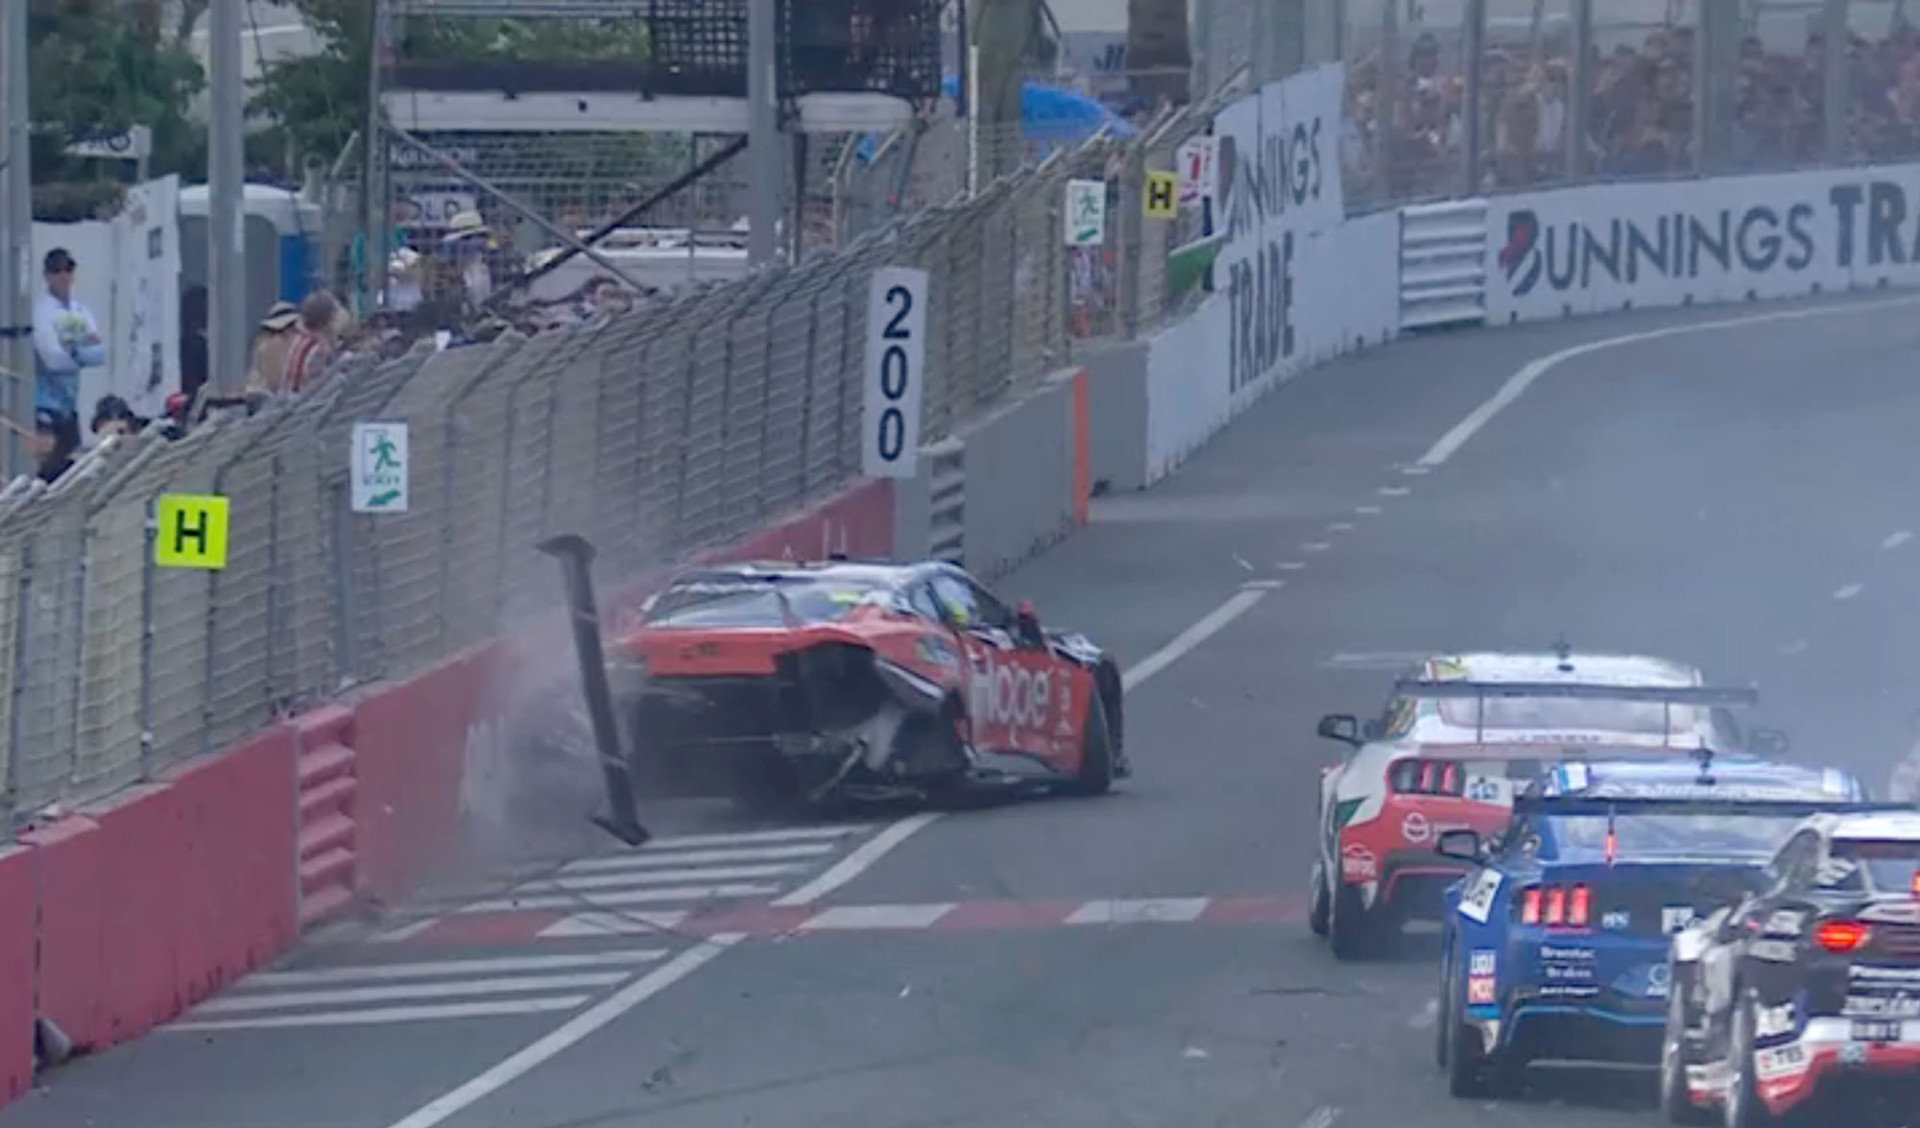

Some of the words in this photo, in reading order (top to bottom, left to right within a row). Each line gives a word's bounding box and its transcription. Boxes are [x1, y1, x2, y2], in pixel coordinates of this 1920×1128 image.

[1148, 180, 1173, 210] H
[1499, 203, 1815, 297] BUNNINGS
[1829, 181, 1920, 267] TR
[1229, 230, 1294, 394] TRADE
[878, 284, 913, 462] 200
[175, 509, 207, 554] H
